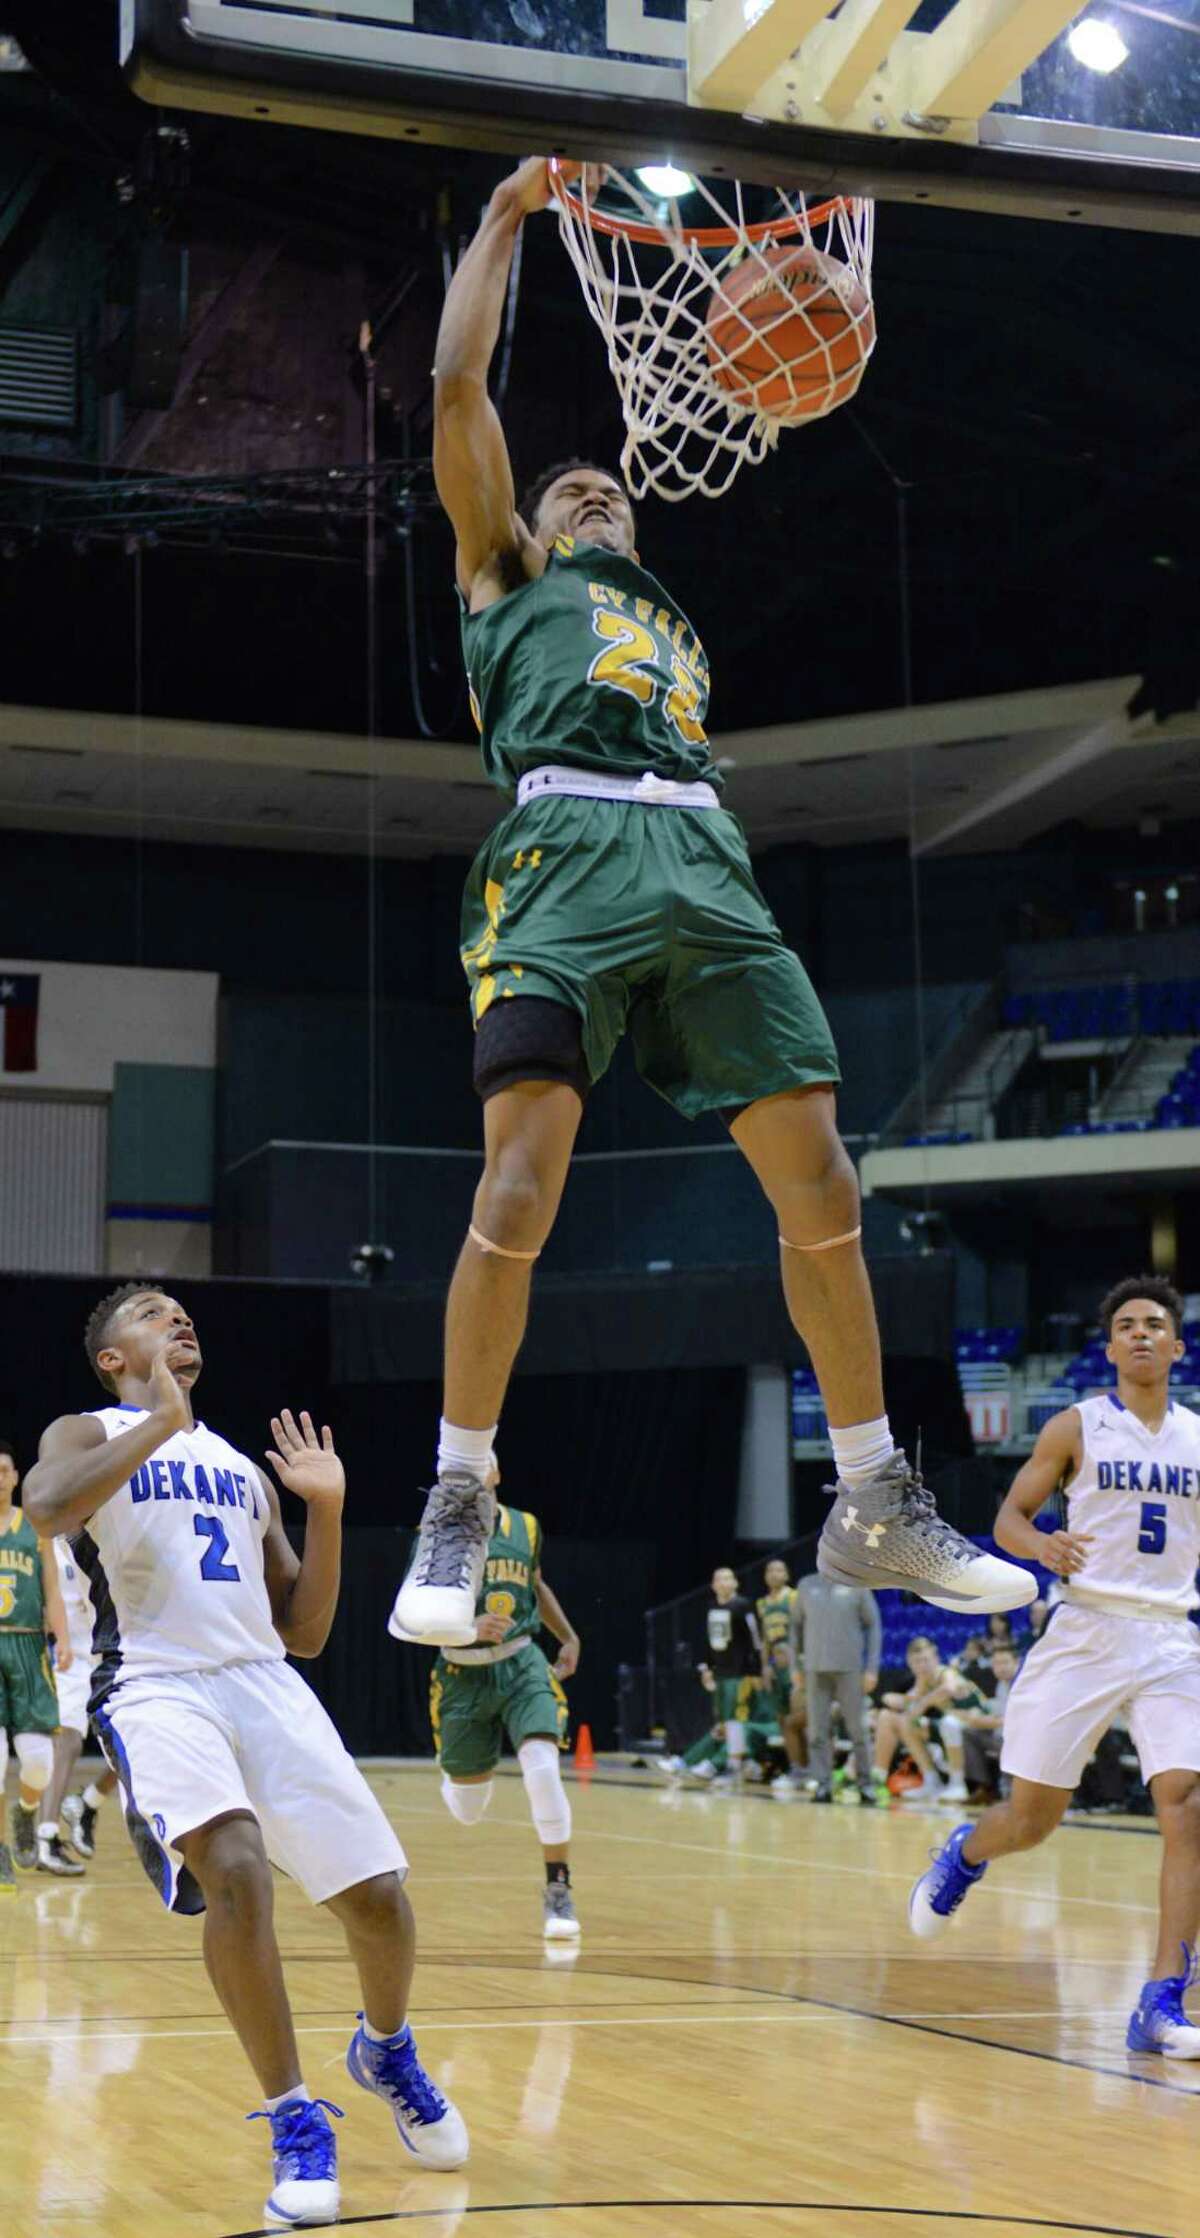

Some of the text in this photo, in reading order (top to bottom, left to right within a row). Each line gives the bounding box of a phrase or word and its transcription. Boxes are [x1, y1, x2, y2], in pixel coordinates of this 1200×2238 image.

[588, 582, 627, 611] CY
[129, 1460, 260, 1520] DEKANE
[193, 1513, 241, 1582] 2
[1137, 1501, 1168, 1555] 5
